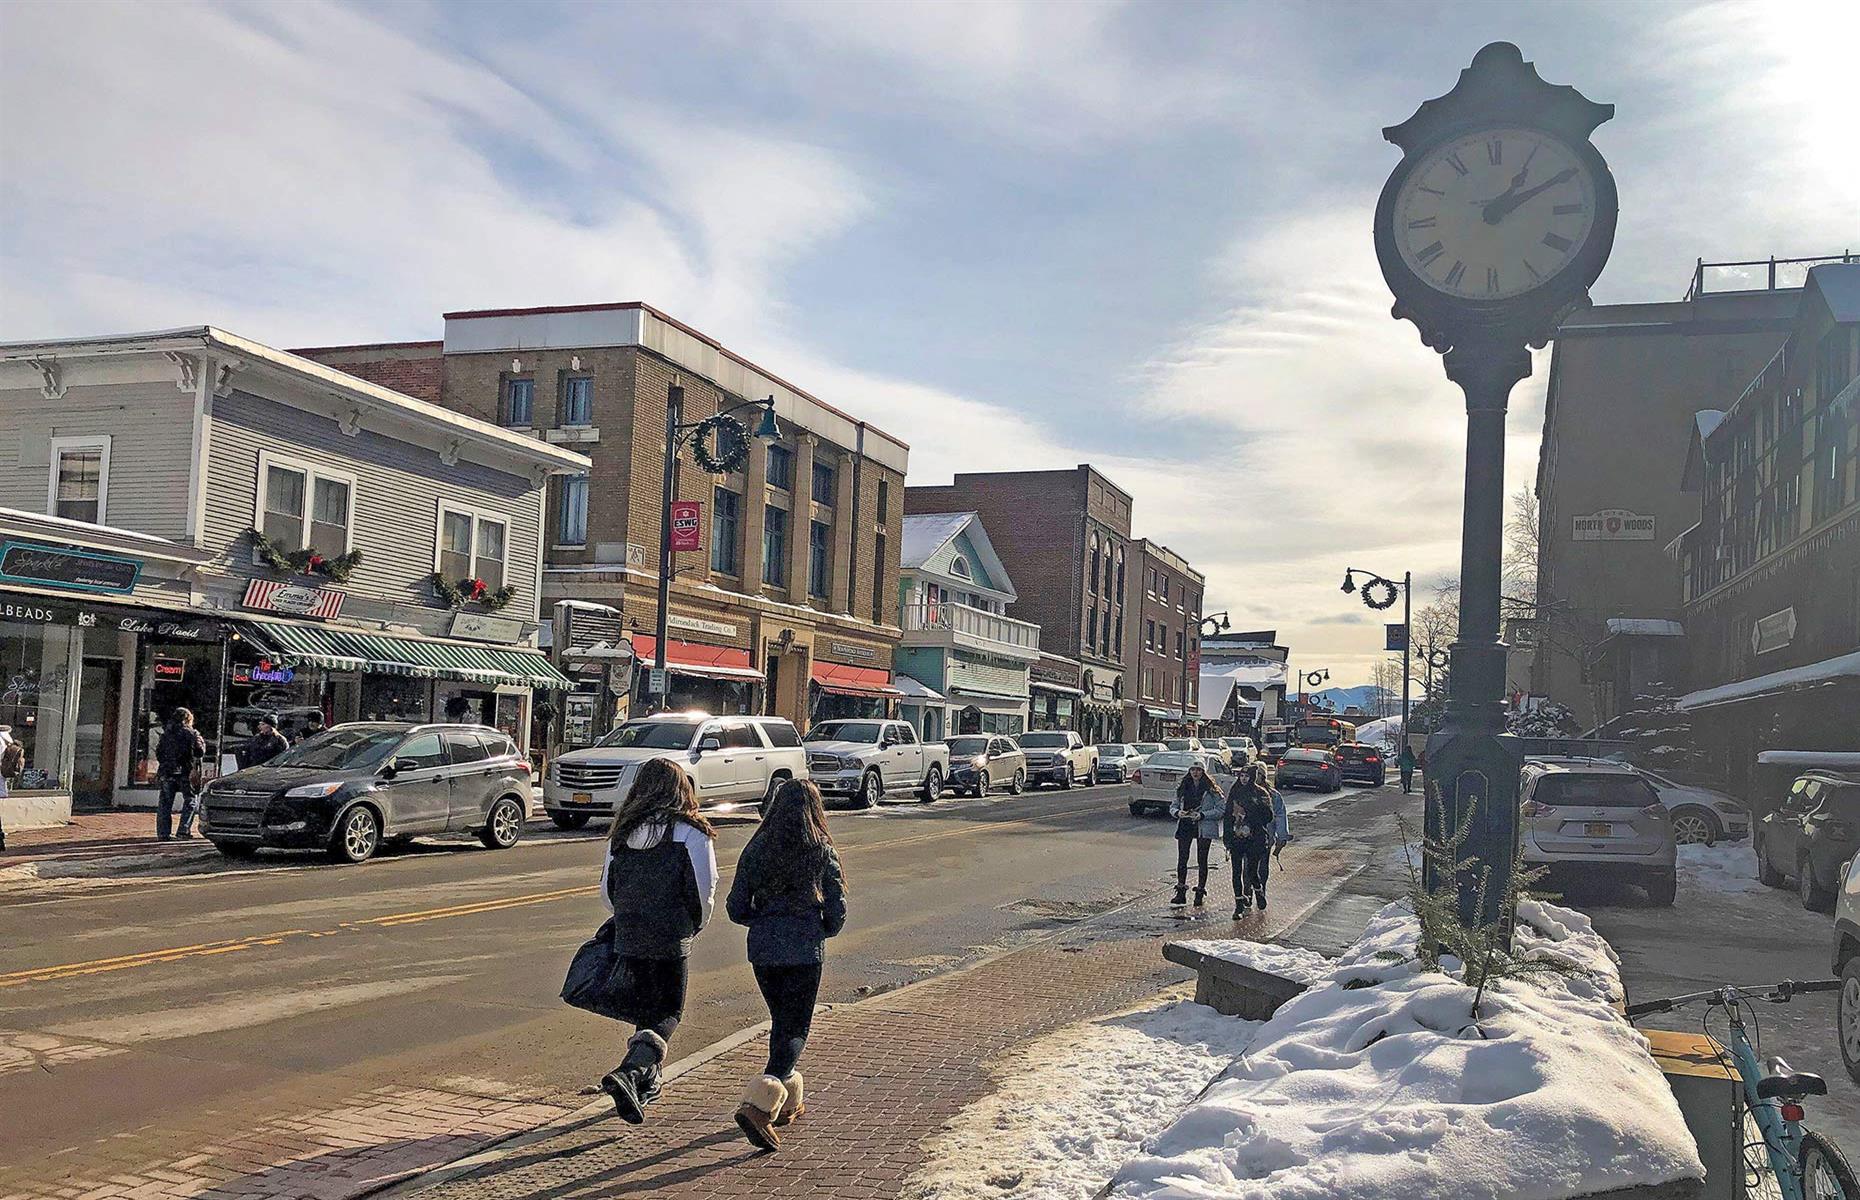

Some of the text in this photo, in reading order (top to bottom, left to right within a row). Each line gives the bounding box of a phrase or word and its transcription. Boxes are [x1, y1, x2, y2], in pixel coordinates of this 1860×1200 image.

[674, 518, 698, 528] ESWG
[1575, 519, 1654, 531] NORTH WOODS
[277, 589, 310, 600] Emma's
[118, 618, 200, 638] Lake Placid
[702, 621, 723, 632] Trading
[155, 664, 182, 675] Cream
